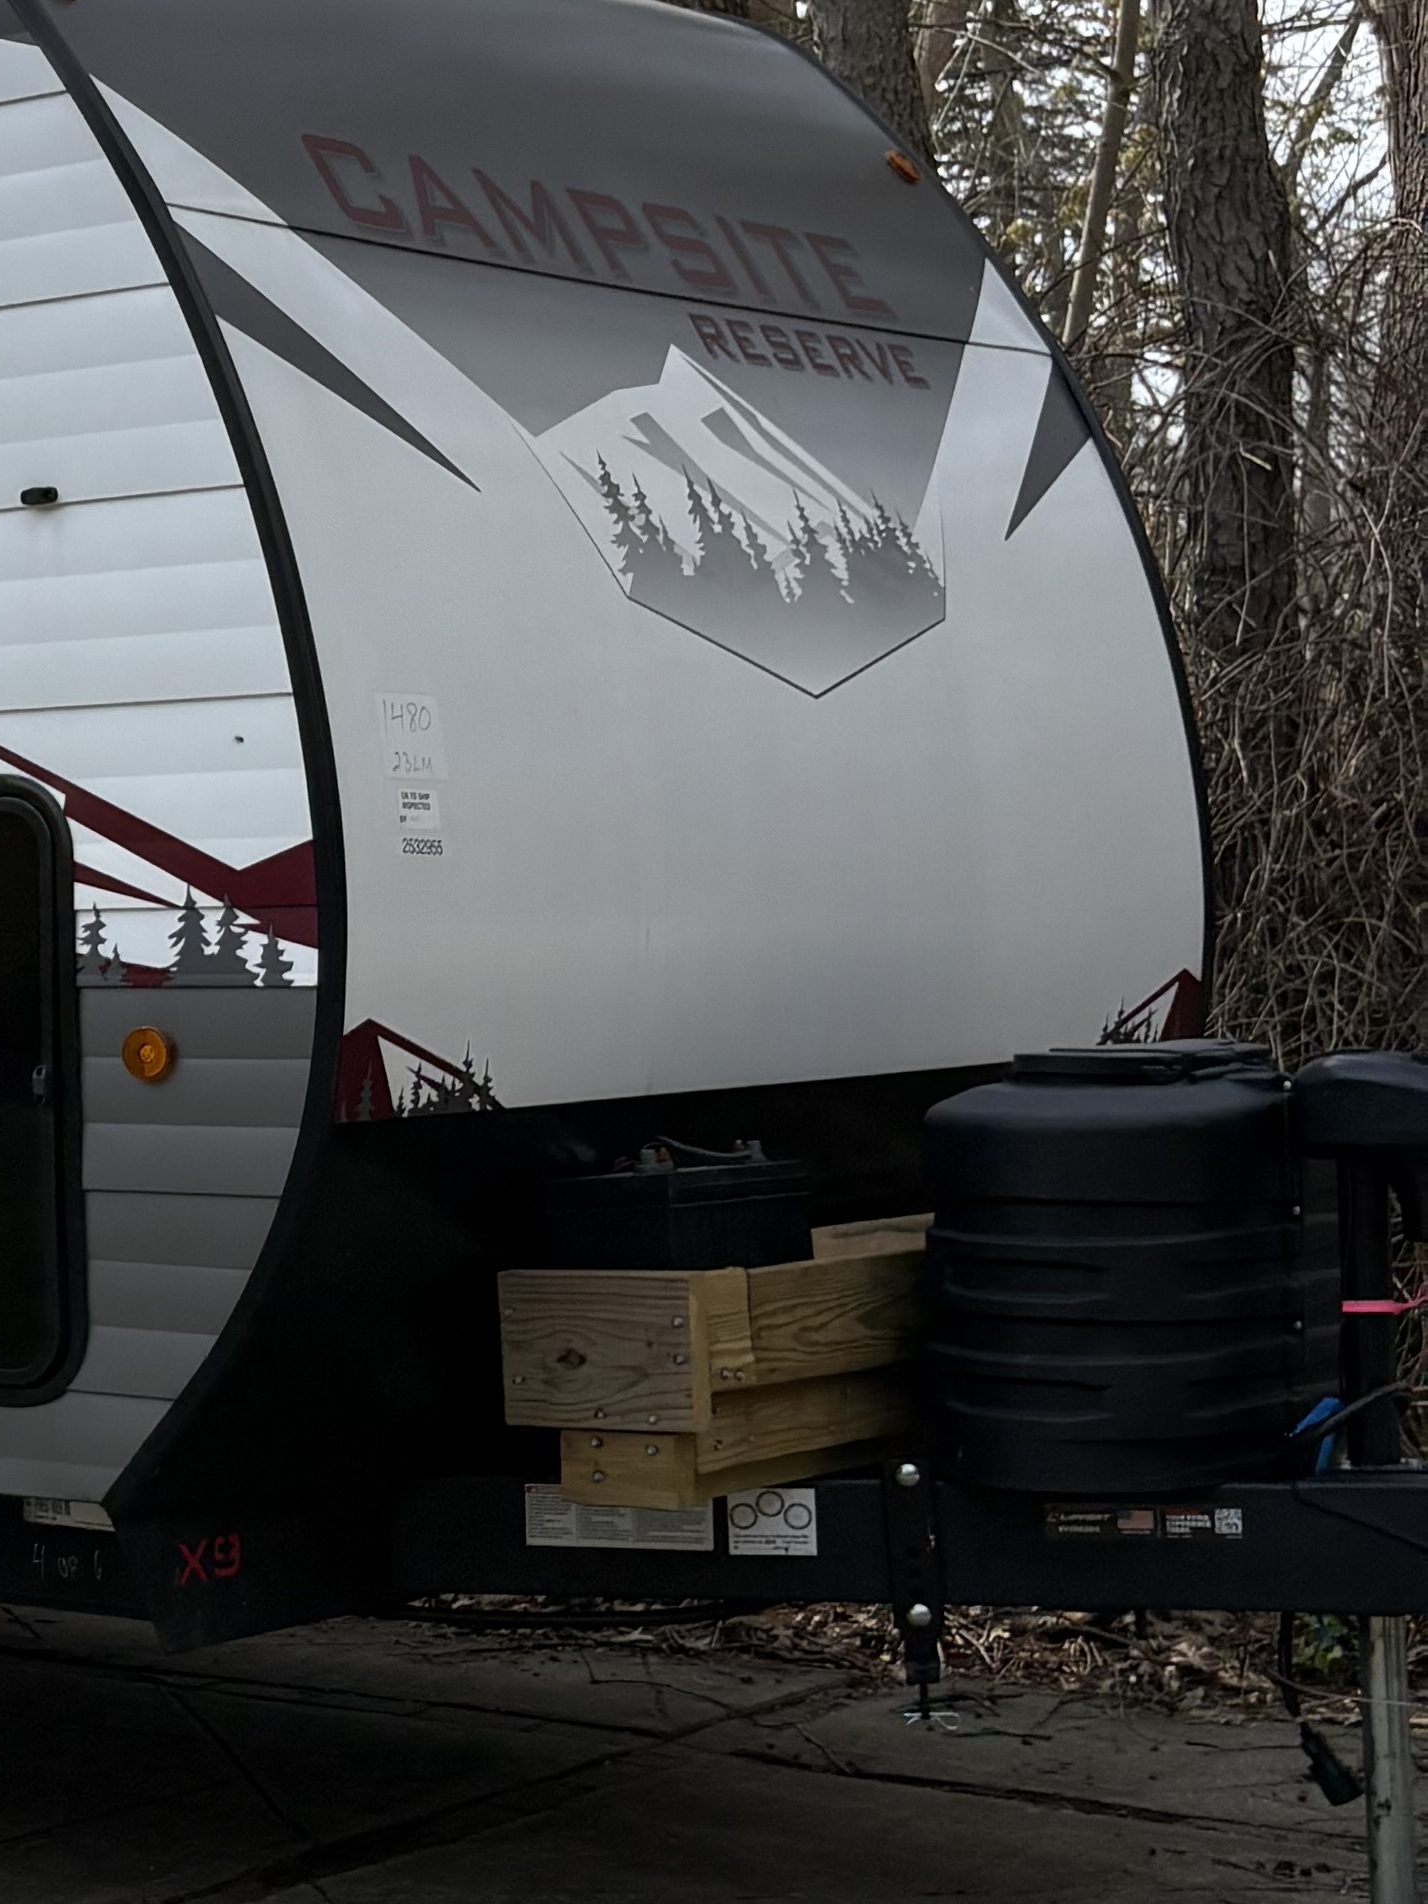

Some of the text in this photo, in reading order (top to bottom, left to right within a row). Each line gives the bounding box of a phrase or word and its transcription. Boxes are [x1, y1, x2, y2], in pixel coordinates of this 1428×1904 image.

[300, 133, 898, 321] CAMPSITE
[686, 311, 932, 391] RESERVE
[382, 699, 431, 734] 1480
